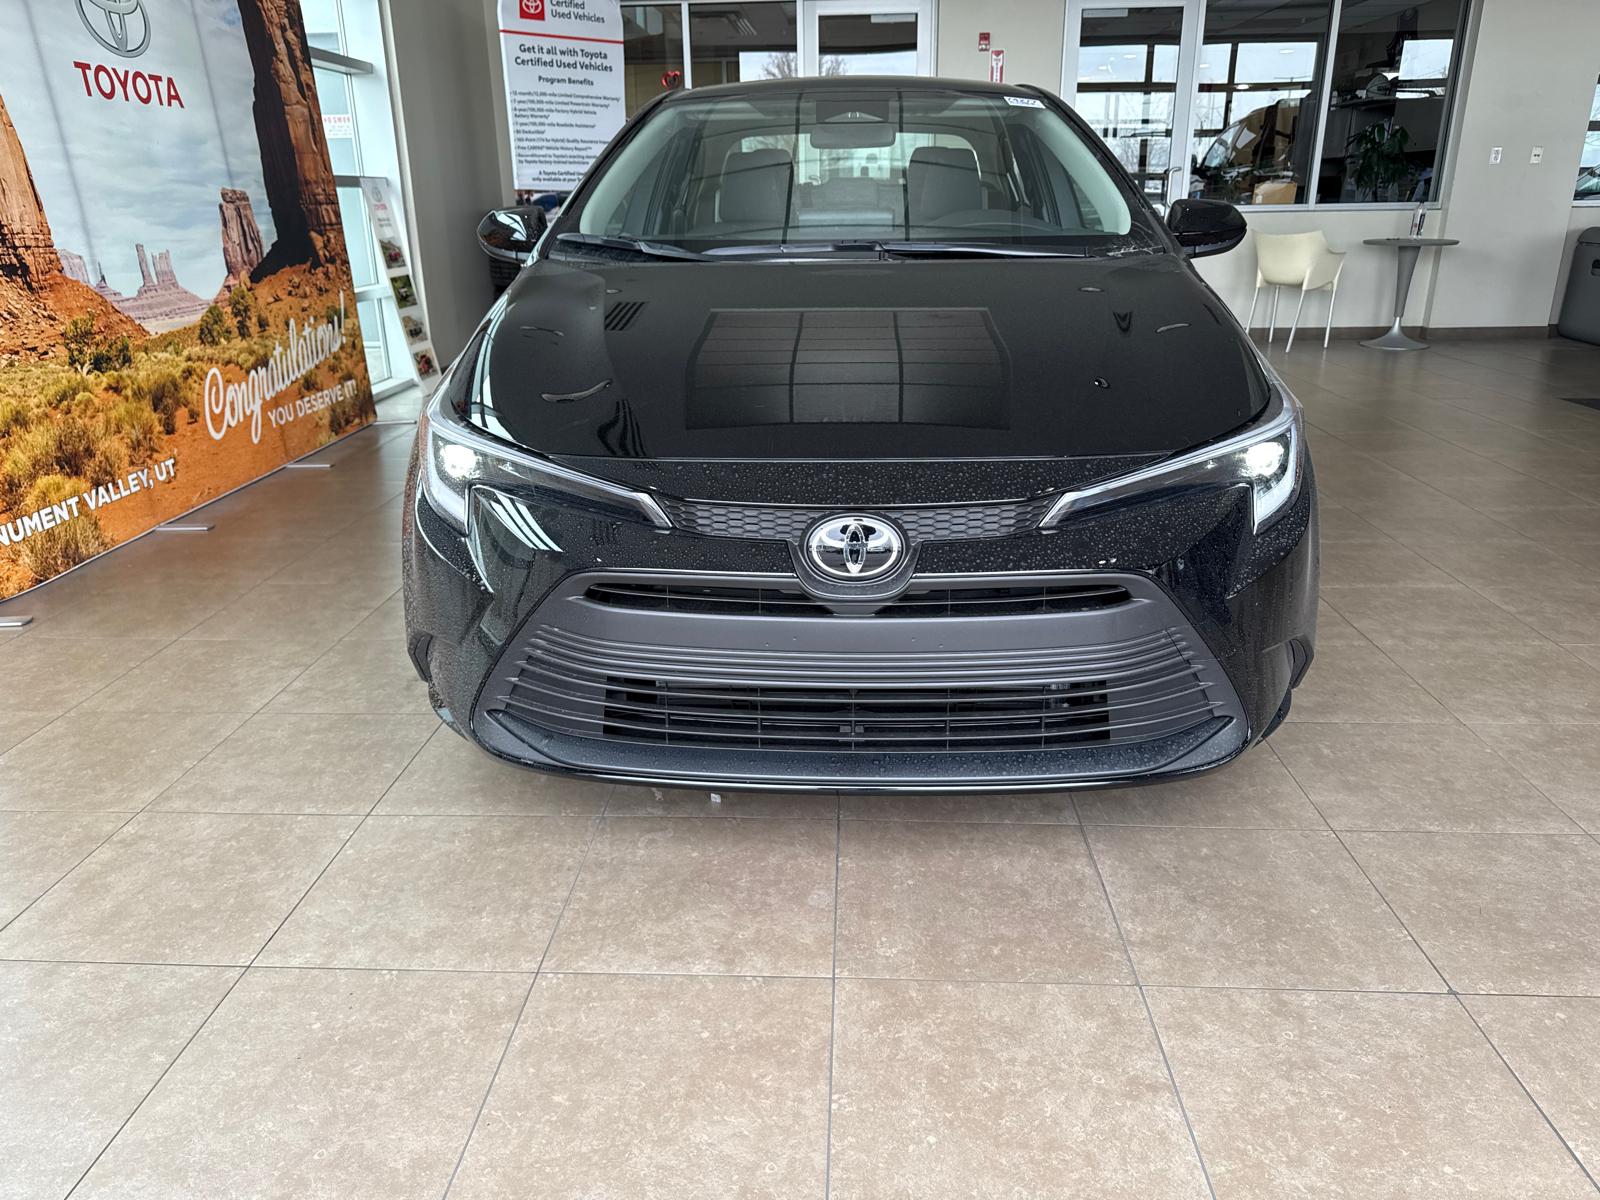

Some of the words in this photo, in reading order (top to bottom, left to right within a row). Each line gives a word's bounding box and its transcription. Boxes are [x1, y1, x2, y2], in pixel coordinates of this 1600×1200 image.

[550, 0, 585, 10] Certified
[551, 9, 572, 19] Used
[573, 12, 605, 23] Vehicles
[519, 44, 536, 54] Get
[537, 44, 544, 55] it
[546, 45, 557, 56] all
[559, 47, 578, 57] with
[580, 49, 607, 60] Toyota
[514, 56, 554, 68] Certified
[556, 59, 577, 69] Used
[579, 61, 613, 72] Vehicles
[73, 60, 185, 108] TOYOTA
[538, 75, 567, 85] Program
[568, 77, 594, 86] Benefits
[204, 290, 346, 444] Congratulations!
[268, 403, 294, 428] YOU
[295, 384, 344, 417] DESERVE
[344, 378, 357, 399] IT!
[0, 496, 79, 546] NUMENT
[82, 468, 154, 511] VALLEY,
[154, 458, 175, 482] UT
